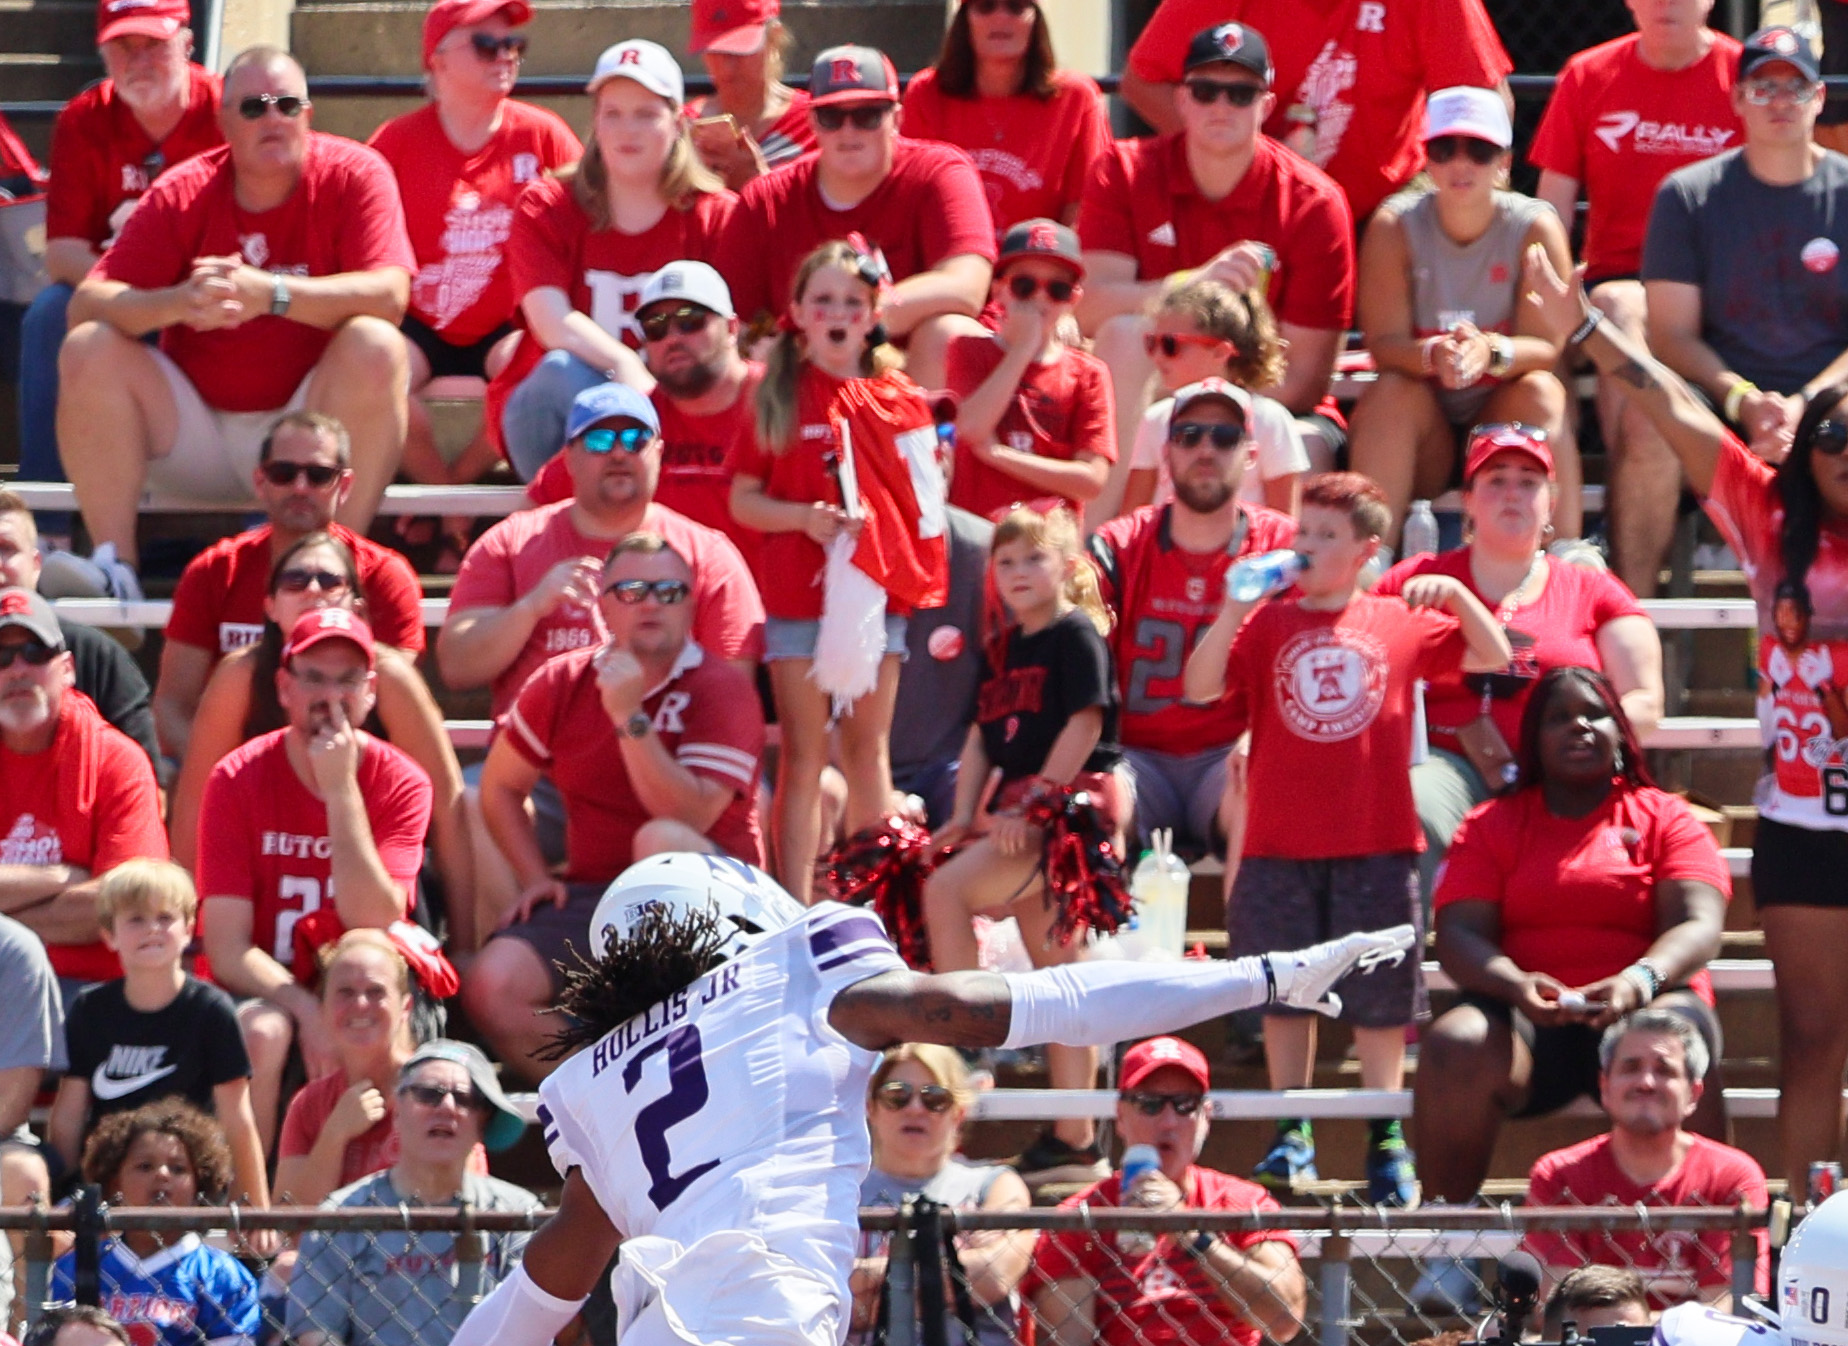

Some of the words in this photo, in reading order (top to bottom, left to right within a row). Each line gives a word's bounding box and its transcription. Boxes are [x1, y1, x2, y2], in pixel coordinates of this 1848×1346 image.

[1358, 3, 1386, 32] R
[620, 48, 639, 65] R
[830, 58, 860, 84] R
[1634, 120, 1735, 147] RALLY
[513, 153, 539, 182] R
[653, 690, 692, 733] R
[262, 831, 332, 860] RUTG
[592, 983, 690, 1078] HOLLIS
[700, 960, 743, 1004] JR
[107, 1044, 170, 1077] NIKE
[622, 1022, 724, 1212] 2
[1810, 1286, 1830, 1325] 0
